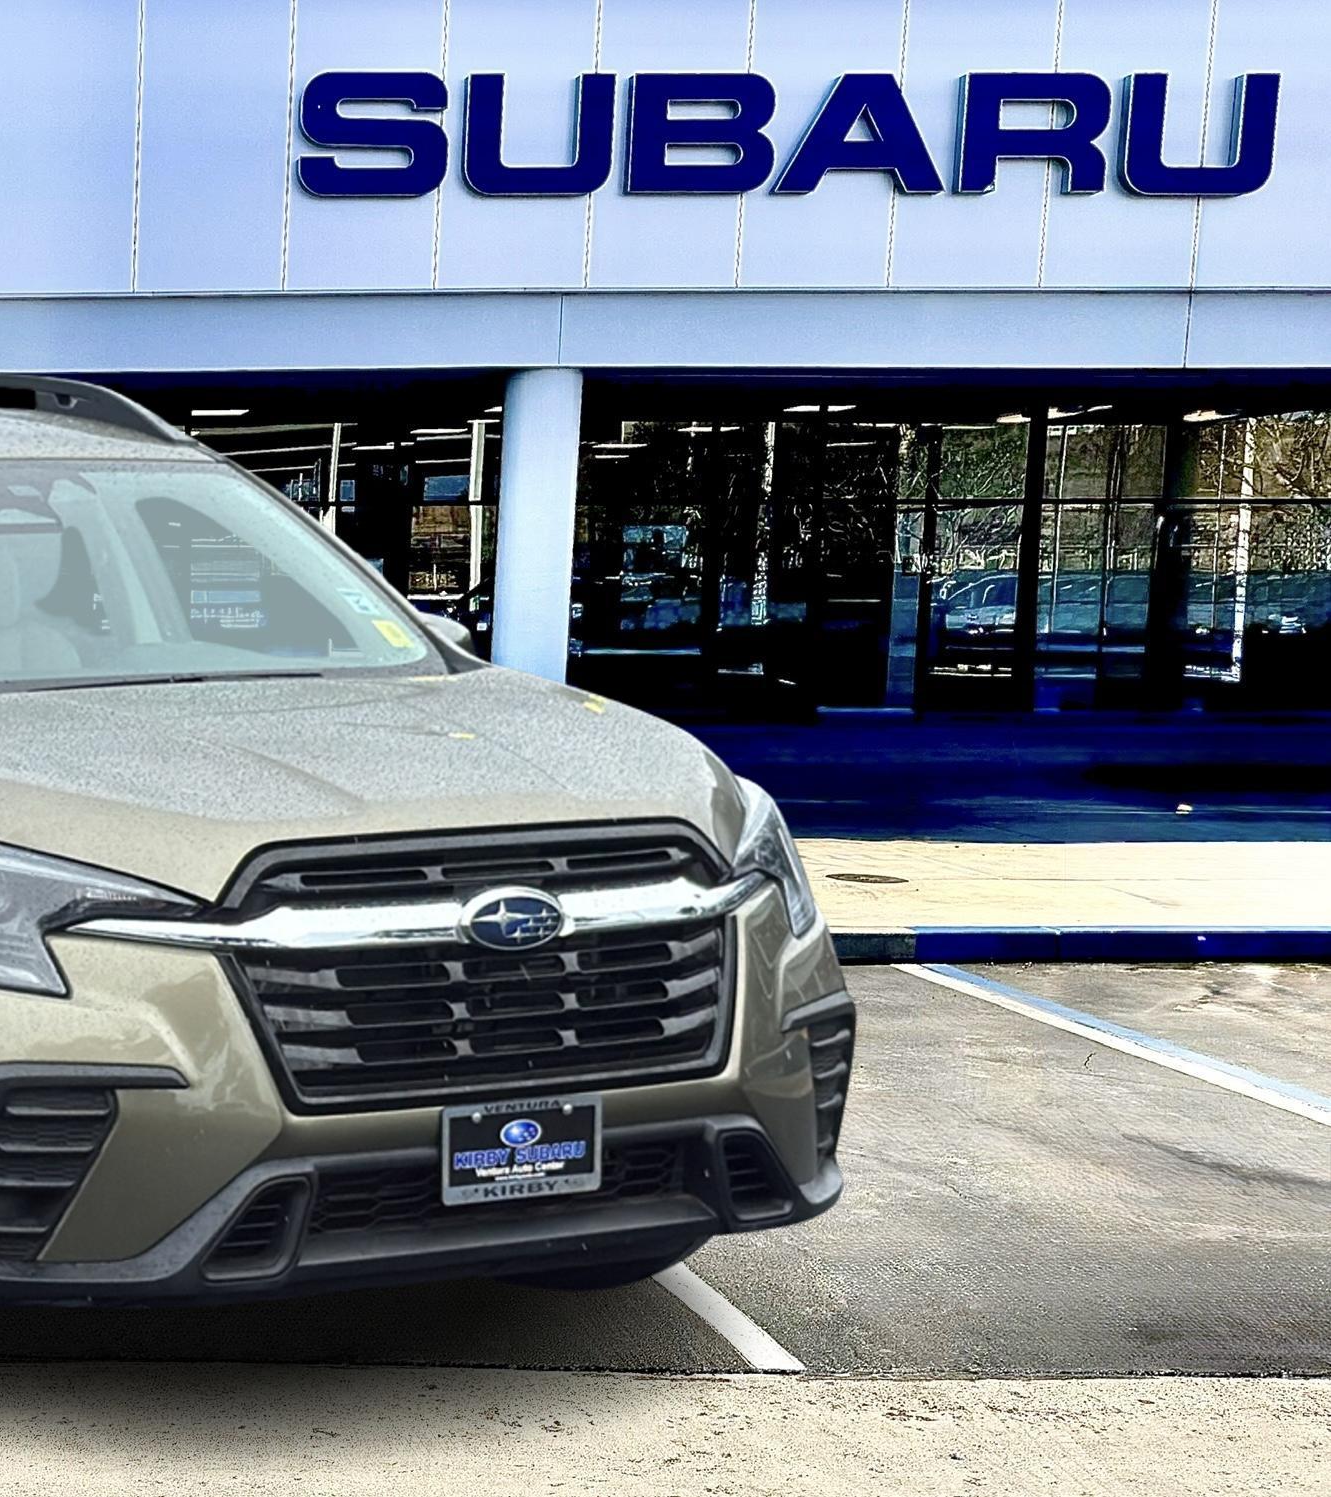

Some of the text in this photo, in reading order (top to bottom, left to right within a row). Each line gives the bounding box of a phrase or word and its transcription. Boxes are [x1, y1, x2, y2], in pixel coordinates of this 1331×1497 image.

[296, 71, 1282, 198] SUBARU
[484, 1100, 560, 1114] VENTURA
[454, 1141, 586, 1170] KIRBY SUBARU
[475, 1166, 510, 1178] Ventura
[512, 1164, 533, 1173] Auto
[535, 1161, 565, 1172] Center
[484, 1180, 557, 1198] KIRBY
